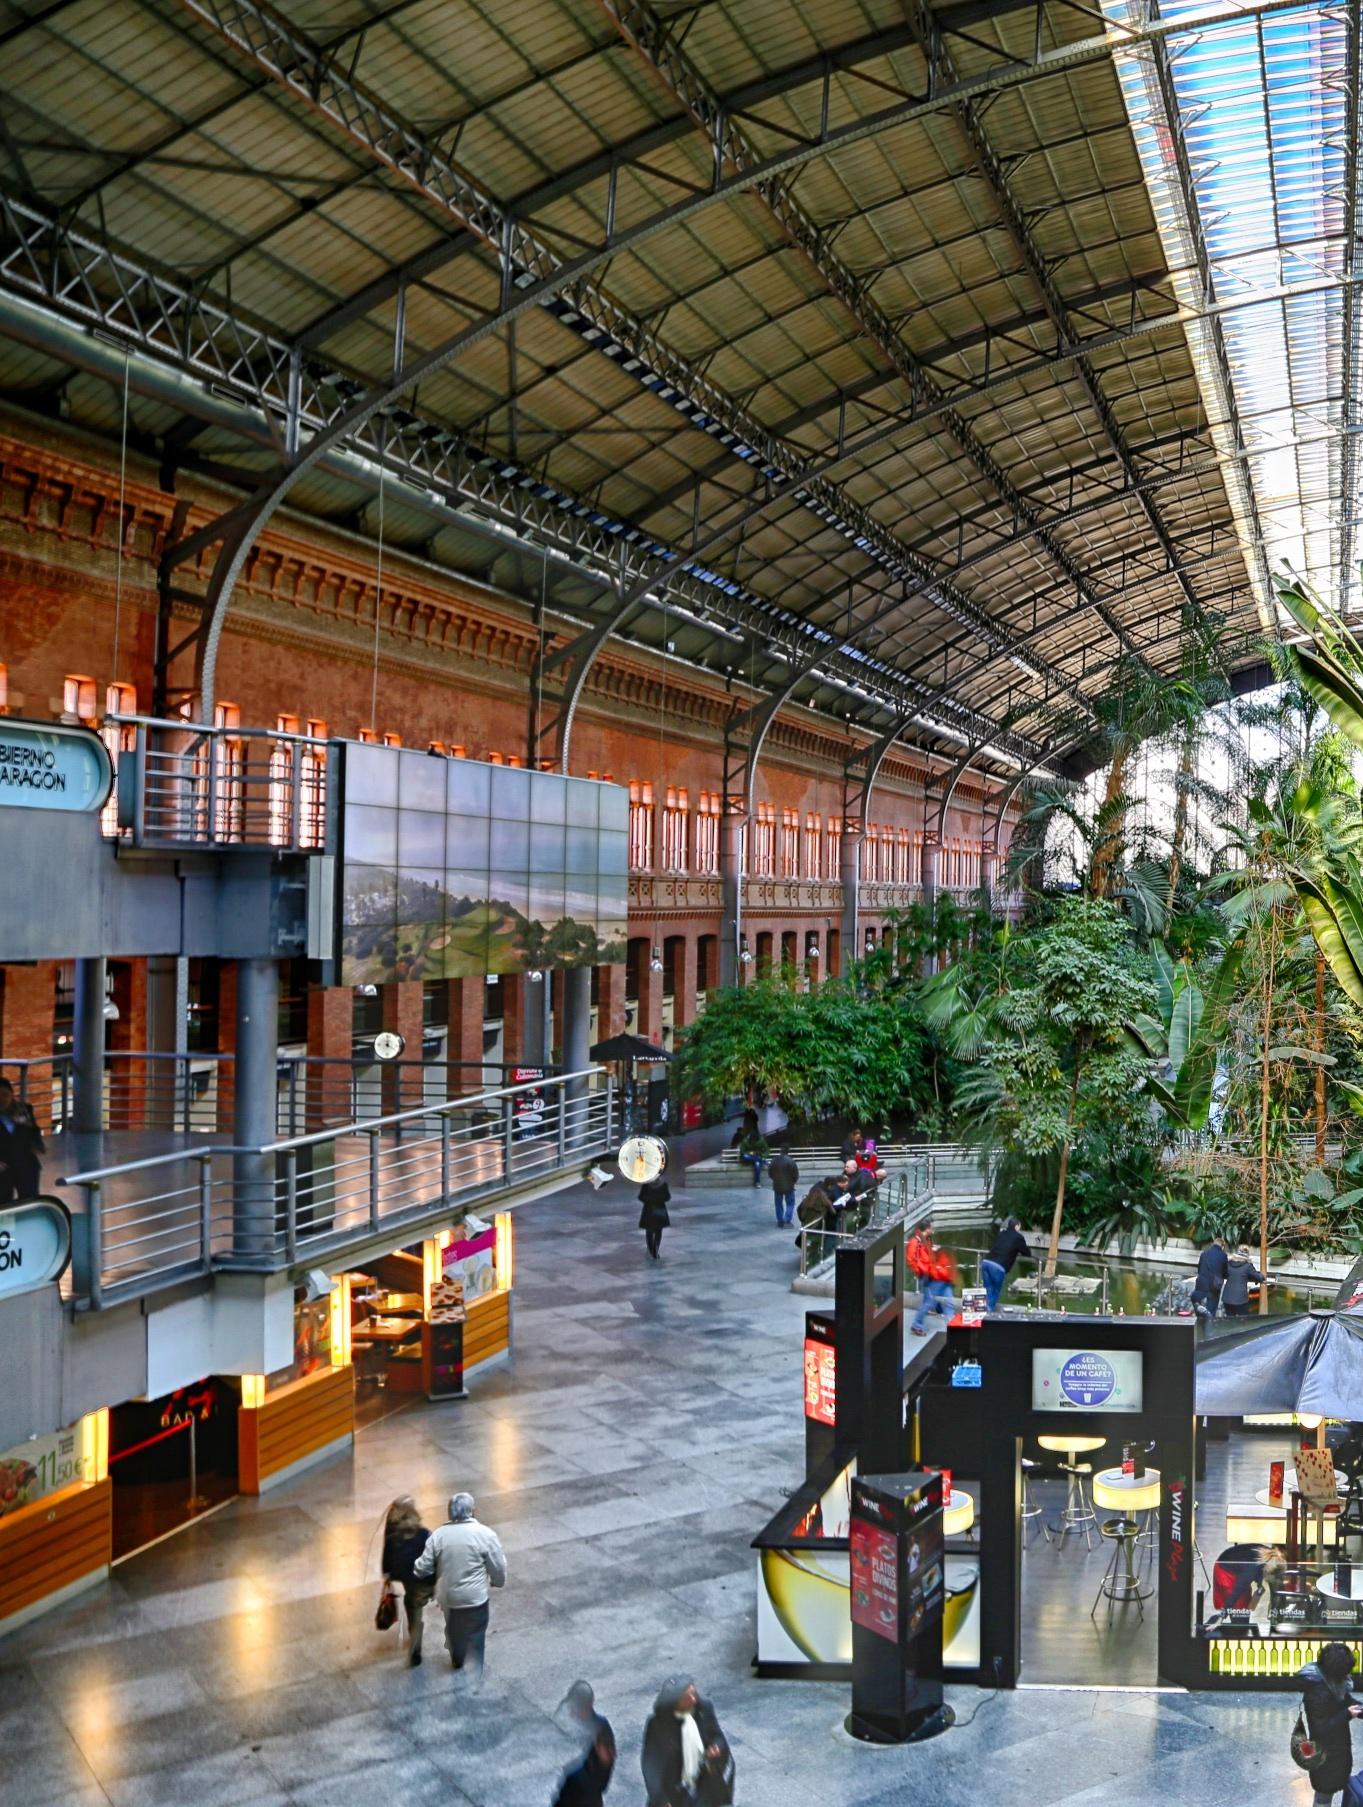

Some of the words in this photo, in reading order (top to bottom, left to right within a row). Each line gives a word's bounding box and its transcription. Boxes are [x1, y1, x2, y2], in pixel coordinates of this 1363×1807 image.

[1068, 1363, 1107, 1371] MOMENTO
[1172, 1491, 1182, 1541] WINE
[872, 1556, 896, 1579] PLATOS
